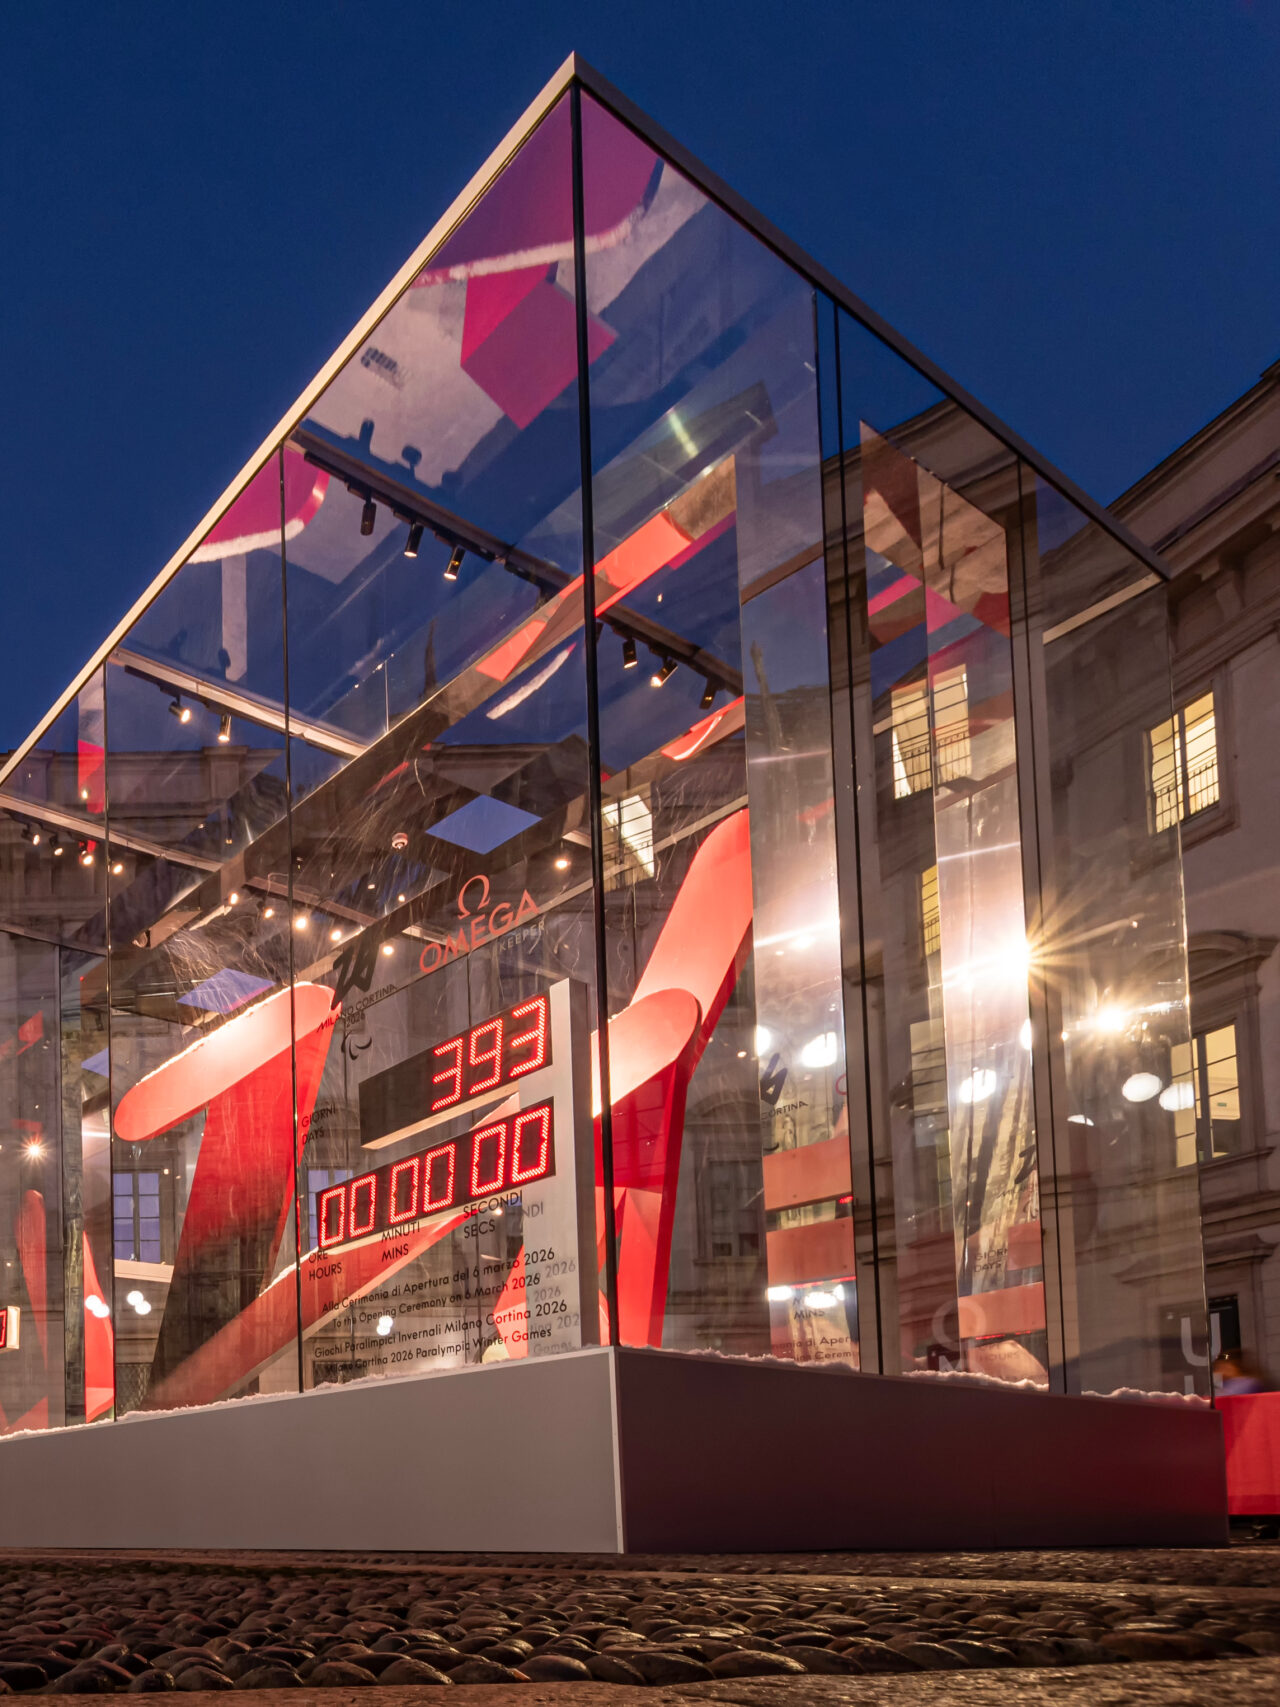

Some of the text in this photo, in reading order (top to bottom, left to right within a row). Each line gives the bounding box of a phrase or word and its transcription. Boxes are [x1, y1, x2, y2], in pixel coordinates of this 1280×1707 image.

[420, 889, 540, 973] OMEGA
[317, 984, 398, 1033] MILANO CORTINA
[431, 997, 547, 1111] 393
[302, 1103, 336, 1127] GIORNI
[302, 1126, 324, 1145] DAYS
[320, 1106, 550, 1248] 00 00 00
[309, 1250, 328, 1264] ORE
[381, 1221, 420, 1243] MINUTI
[463, 1190, 523, 1219] SECONDI
[309, 1219, 496, 1280] HOURS MINS SECS
[322, 1247, 555, 1313] Alla Cerimonia di Apertura del 6 marzo 2026
[332, 1272, 541, 1328] To the Opening Ceremony on 6 March 2026
[314, 1299, 567, 1358] Giochi Paralimpici Invernali Milano Cortina 2026
[355, 1355, 388, 1369] Cortina
[391, 1351, 414, 1363] 2026
[416, 1341, 470, 1358] Paralympic
[472, 1334, 508, 1348] Winter
[511, 1328, 552, 1343] Games
